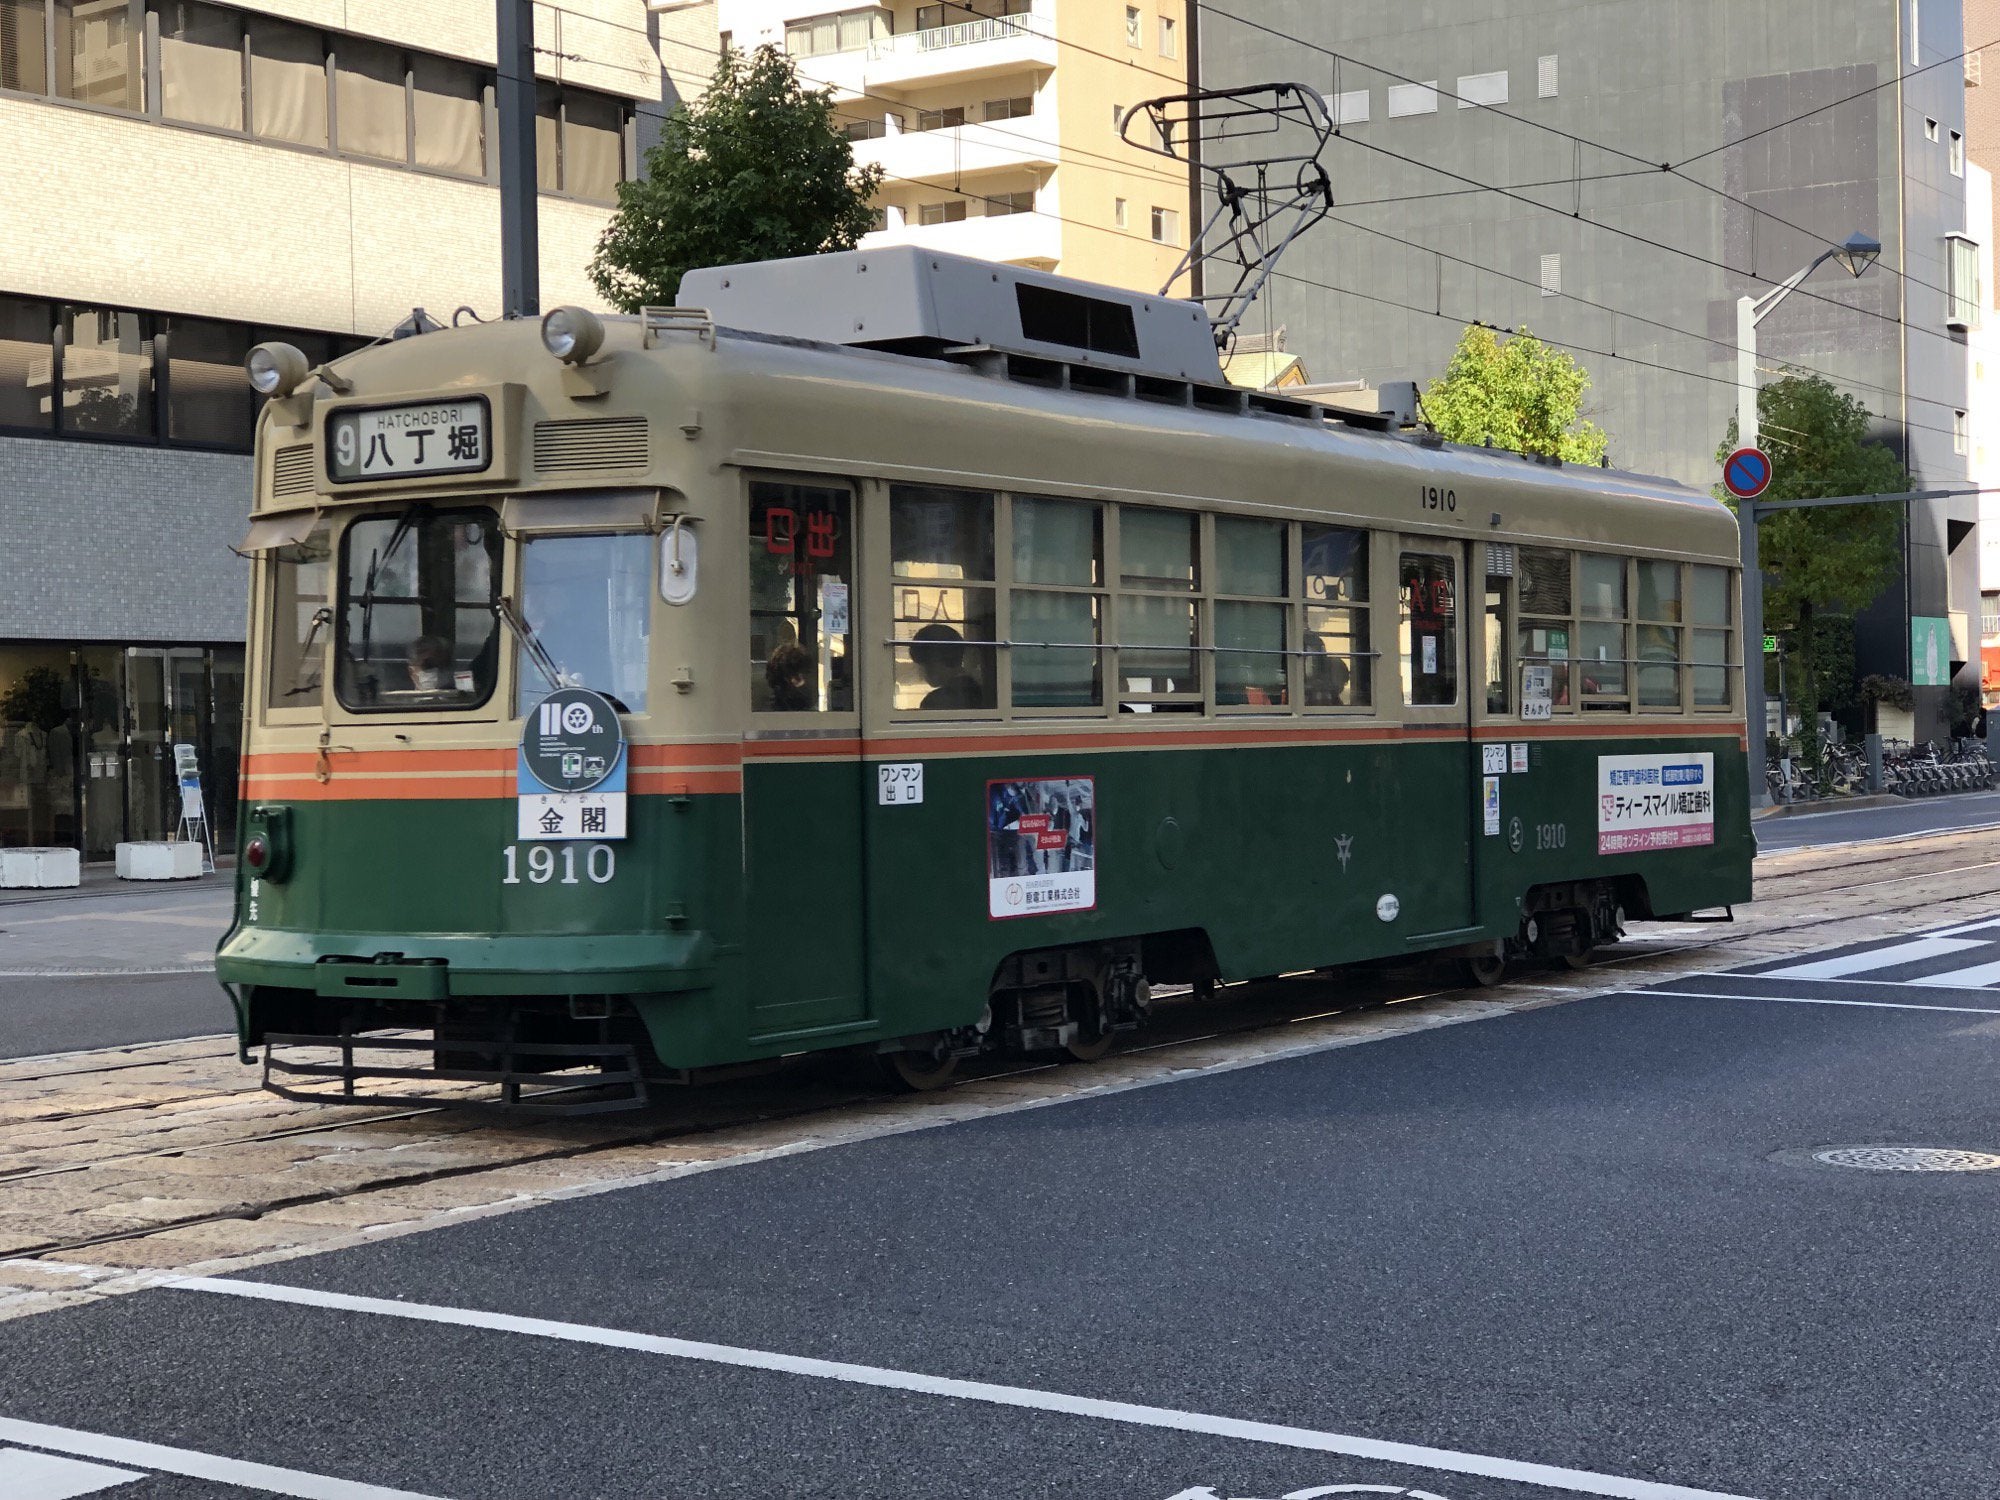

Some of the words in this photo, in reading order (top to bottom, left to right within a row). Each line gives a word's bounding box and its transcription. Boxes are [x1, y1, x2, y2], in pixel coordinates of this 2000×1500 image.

[377, 409, 463, 429] HATCHOBORI
[336, 425, 356, 467] 9
[364, 425, 479, 469] 八丁堀
[1422, 486, 1456, 512] 1910
[1524, 702, 1550, 716] きんかく
[1483, 747, 1506, 758] ワンマン
[1486, 760, 1503, 771] 入口
[881, 768, 921, 783] ワンマン
[886, 785, 916, 801] 出口
[1615, 790, 1711, 819] ティースマイル矯正歯科
[538, 807, 607, 834] 金閣
[1536, 823, 1566, 850] 1910
[503, 844, 616, 884] 1910
